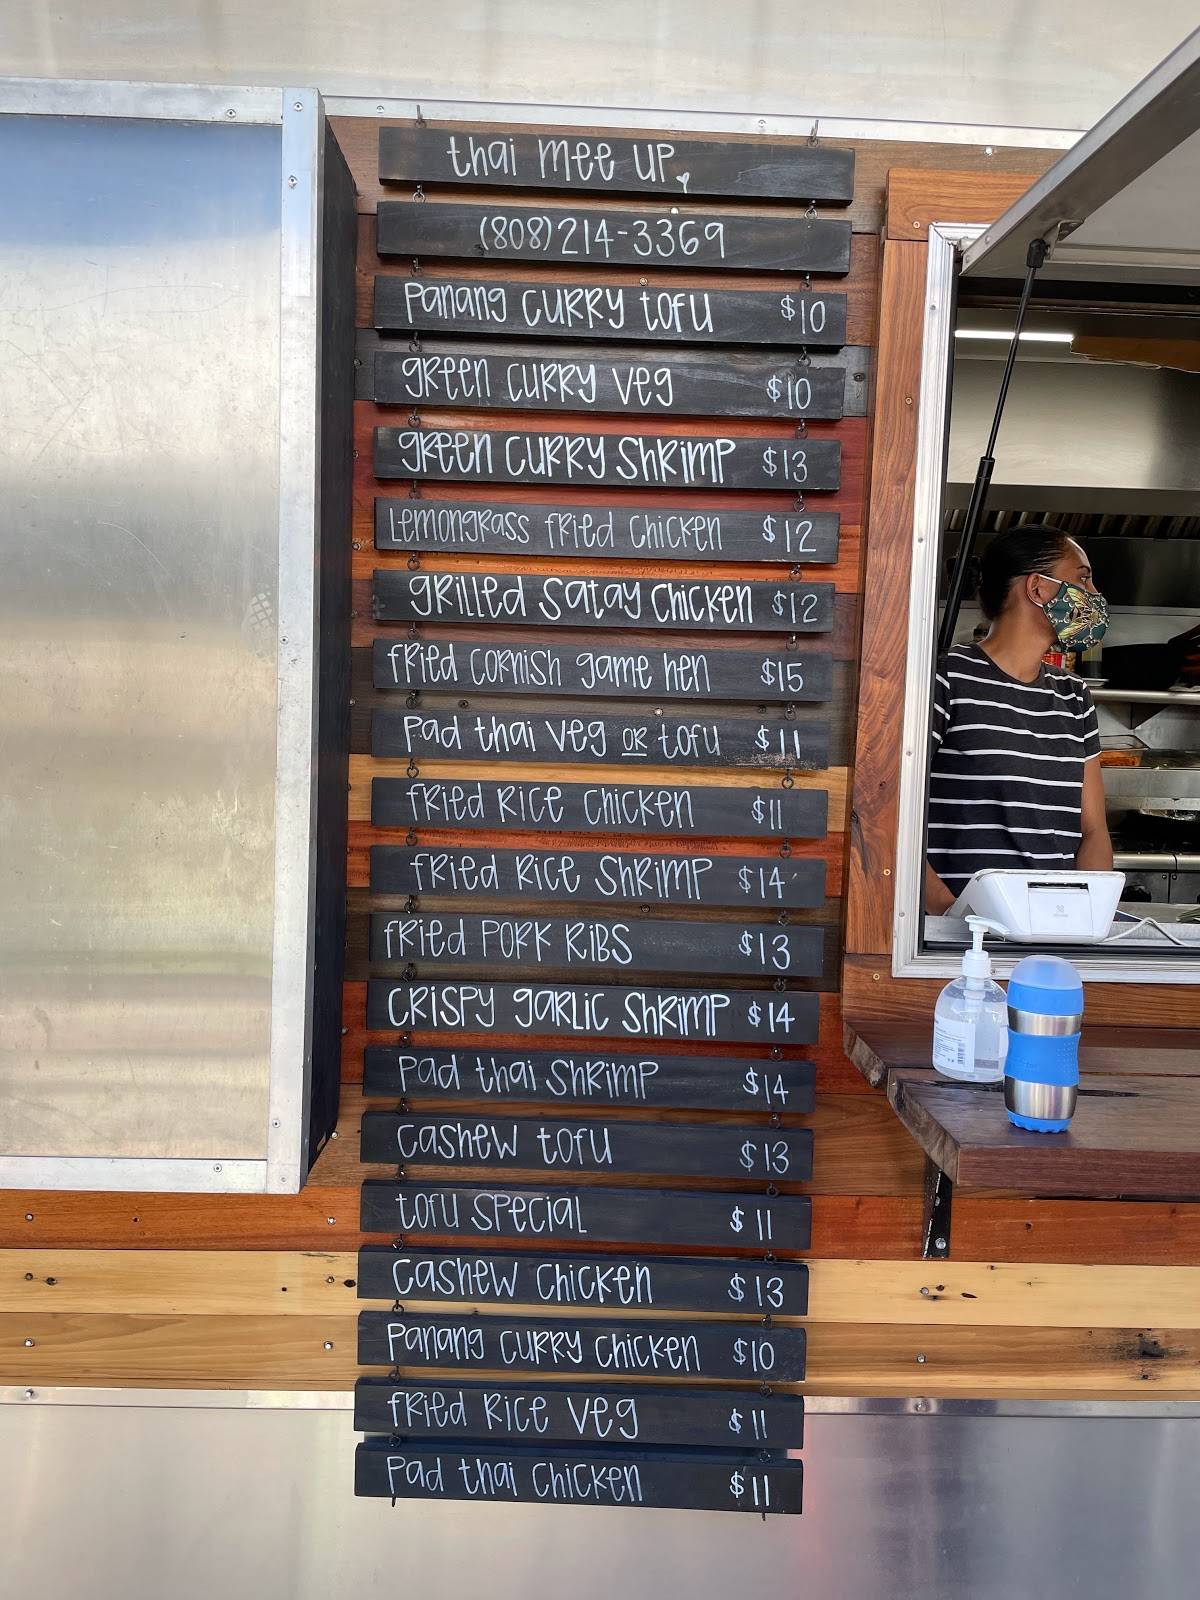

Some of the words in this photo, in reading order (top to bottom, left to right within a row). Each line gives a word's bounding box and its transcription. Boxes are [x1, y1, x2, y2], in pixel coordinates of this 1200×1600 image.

[781, 291, 826, 334] $10
[766, 373, 811, 409] $10
[762, 447, 807, 482] $13
[762, 515, 816, 552] $12
[772, 590, 817, 623] $12
[761, 658, 803, 692] $15
[739, 866, 785, 899] $14
[739, 930, 790, 969] $13
[748, 1001, 795, 1033] $14
[743, 1067, 789, 1104] $14
[740, 1140, 789, 1174] $13
[728, 1273, 783, 1307] $13
[733, 1338, 774, 1372] $10
